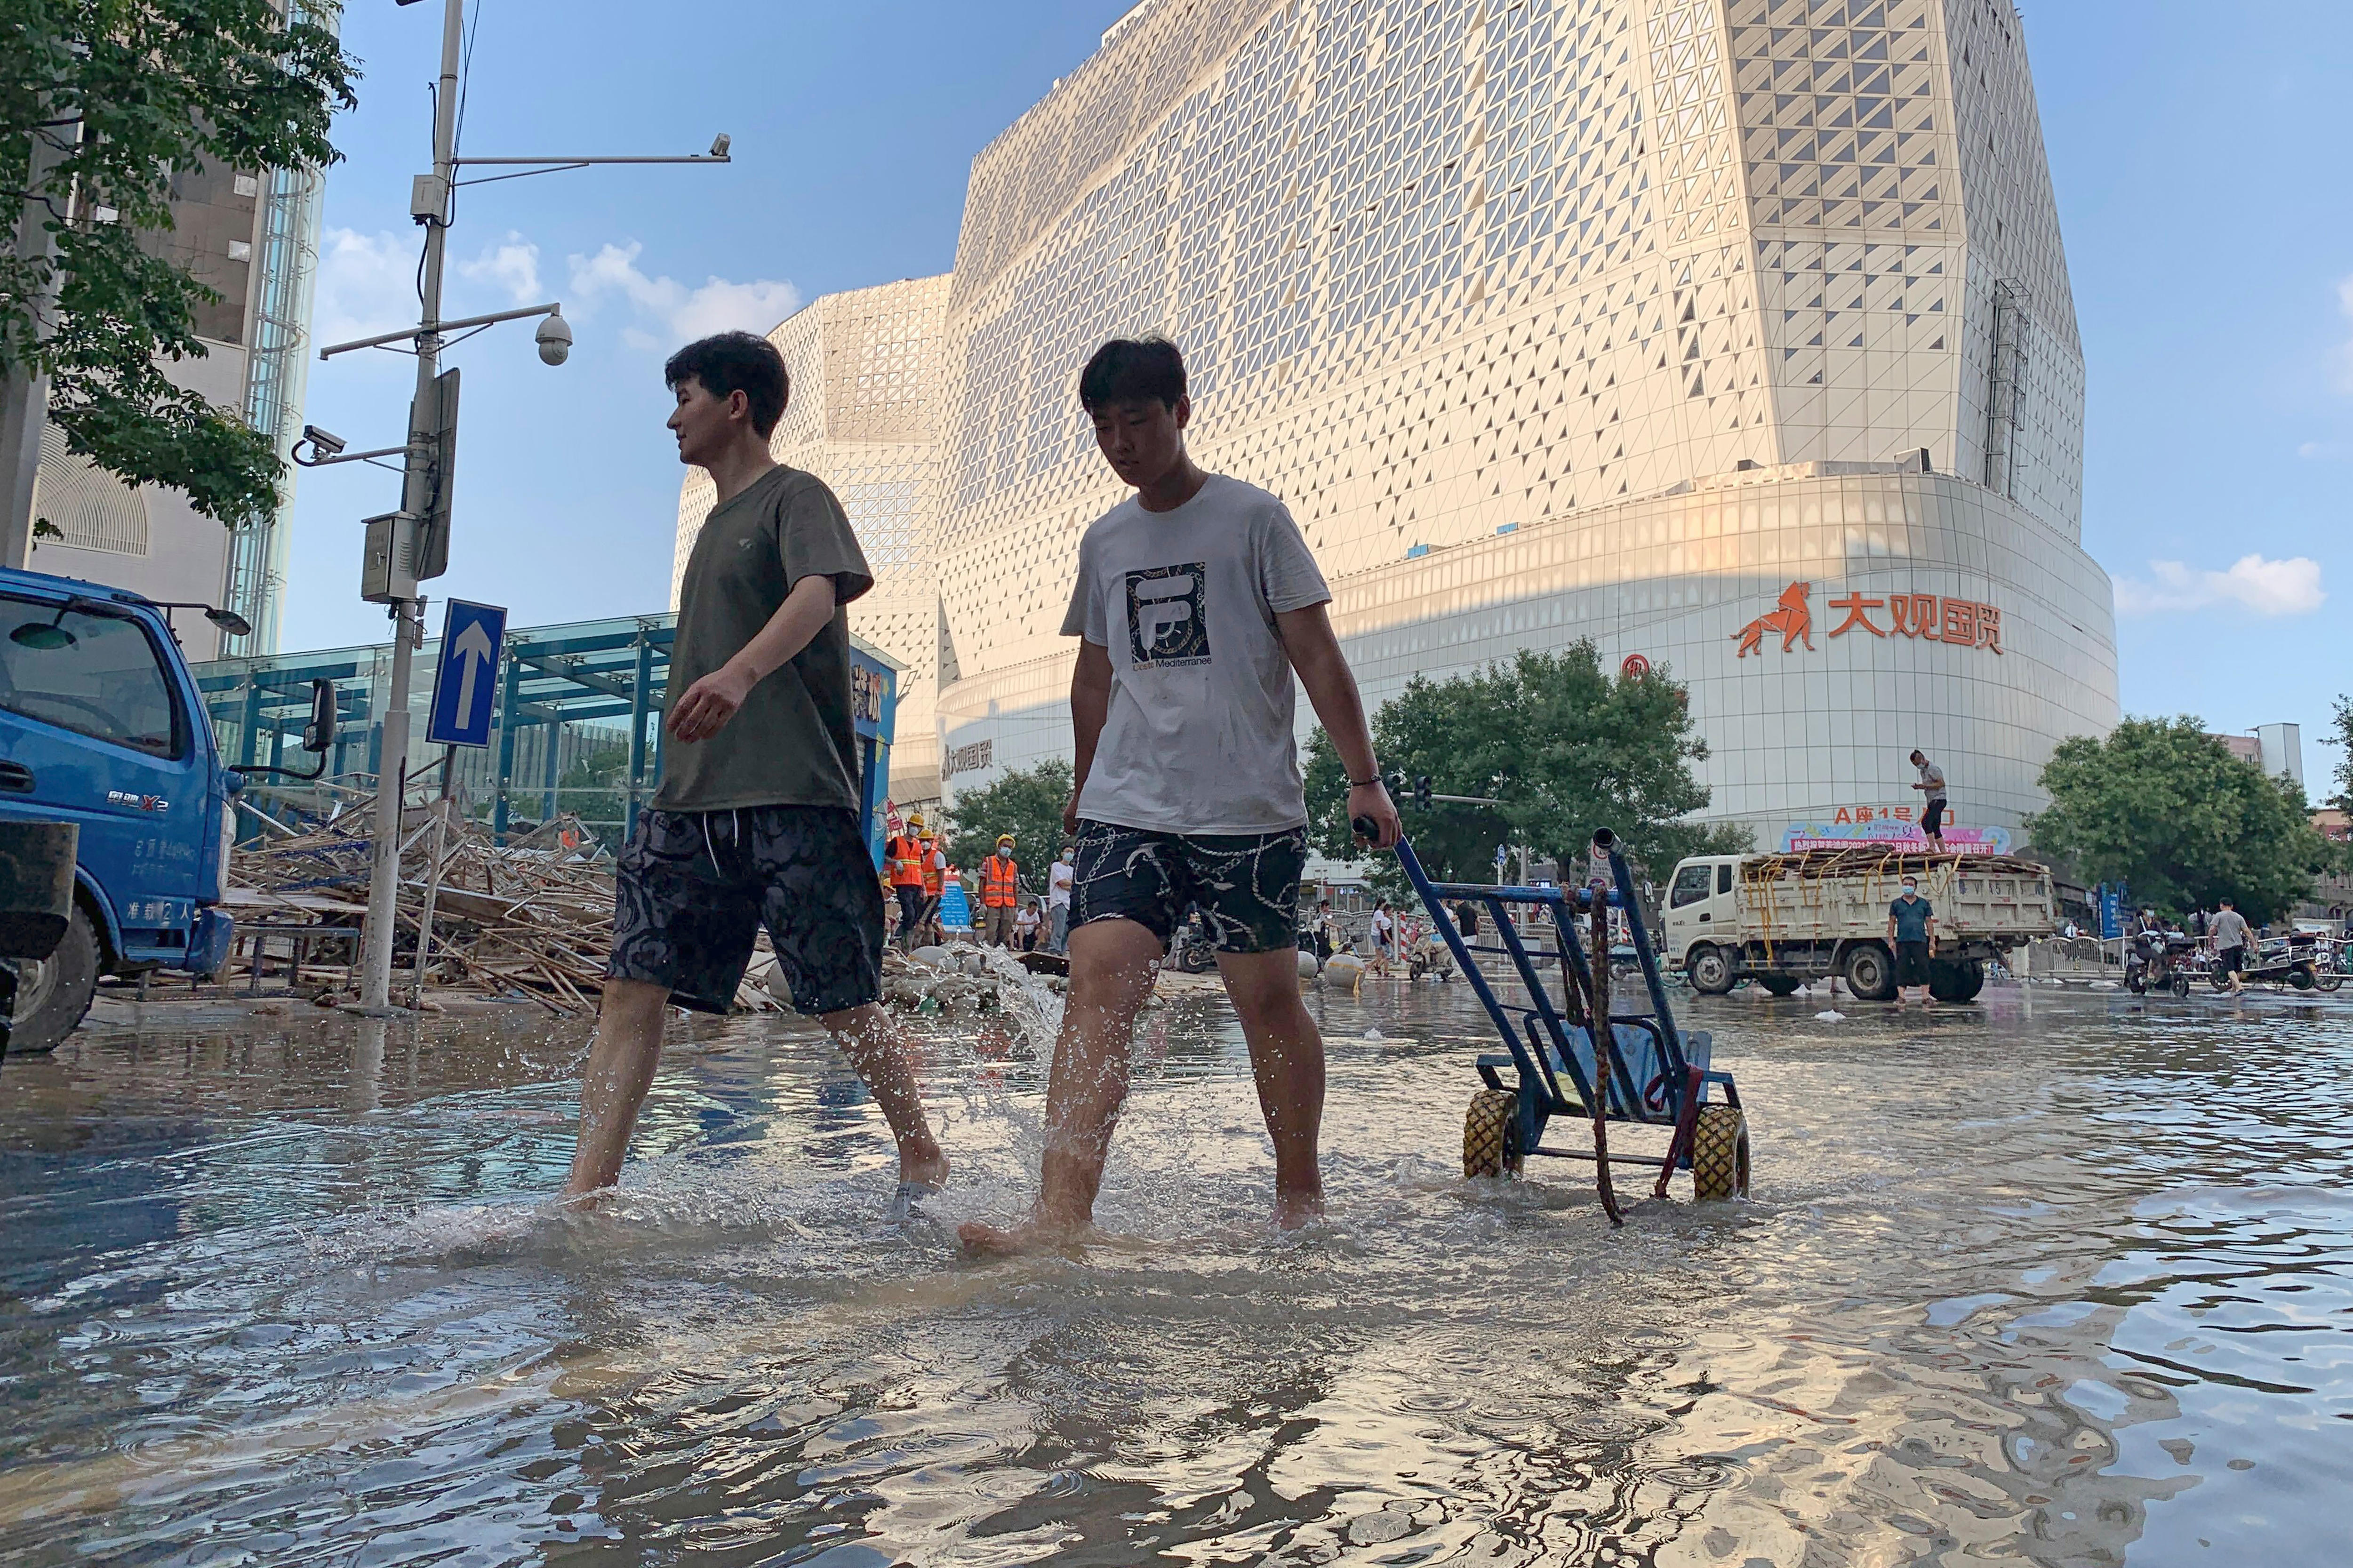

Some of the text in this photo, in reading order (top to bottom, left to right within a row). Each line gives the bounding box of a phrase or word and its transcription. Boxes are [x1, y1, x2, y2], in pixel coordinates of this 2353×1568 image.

[1828, 592, 2004, 655] 大观国贸
[950, 739, 993, 775] 大观国贸
[1833, 806, 1955, 826] A座1号口
